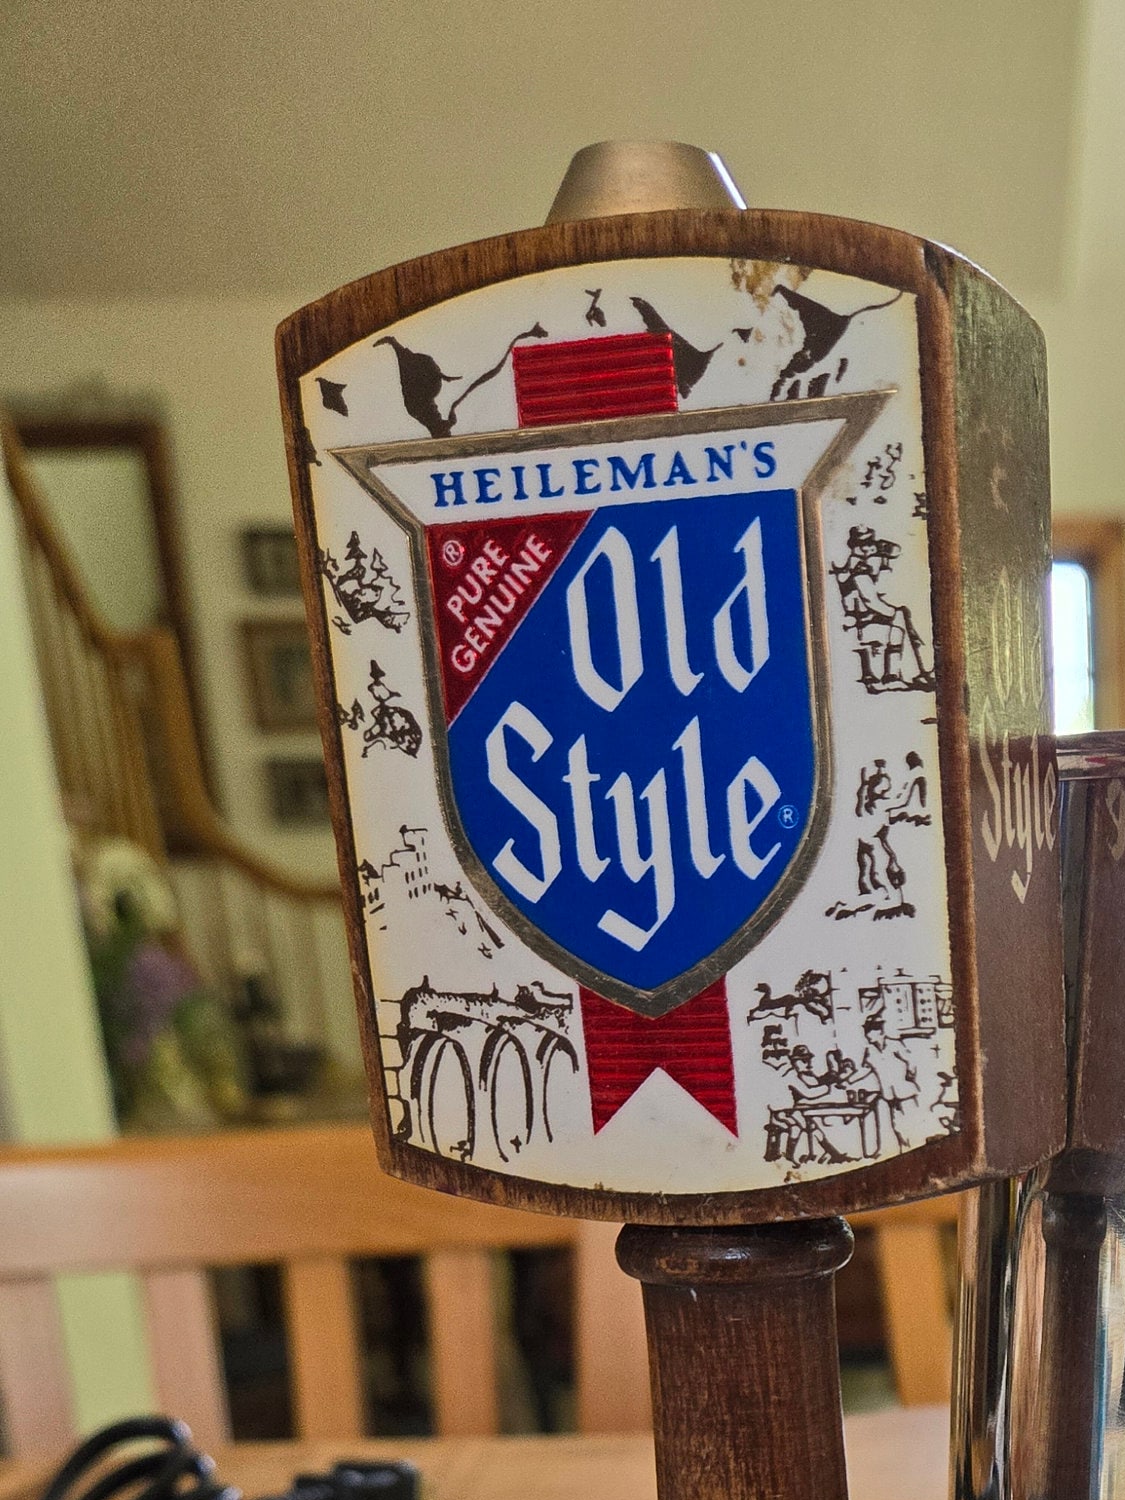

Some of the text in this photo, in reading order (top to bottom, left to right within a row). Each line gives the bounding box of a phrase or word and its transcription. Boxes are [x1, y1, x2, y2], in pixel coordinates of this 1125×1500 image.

[431, 440, 777, 508] HEILEMAN'S
[447, 539, 510, 622] PURE
[451, 533, 553, 673] GENUINE
[566, 515, 770, 713] Old
[486, 700, 782, 952] Style
[980, 695, 1057, 905] Style
